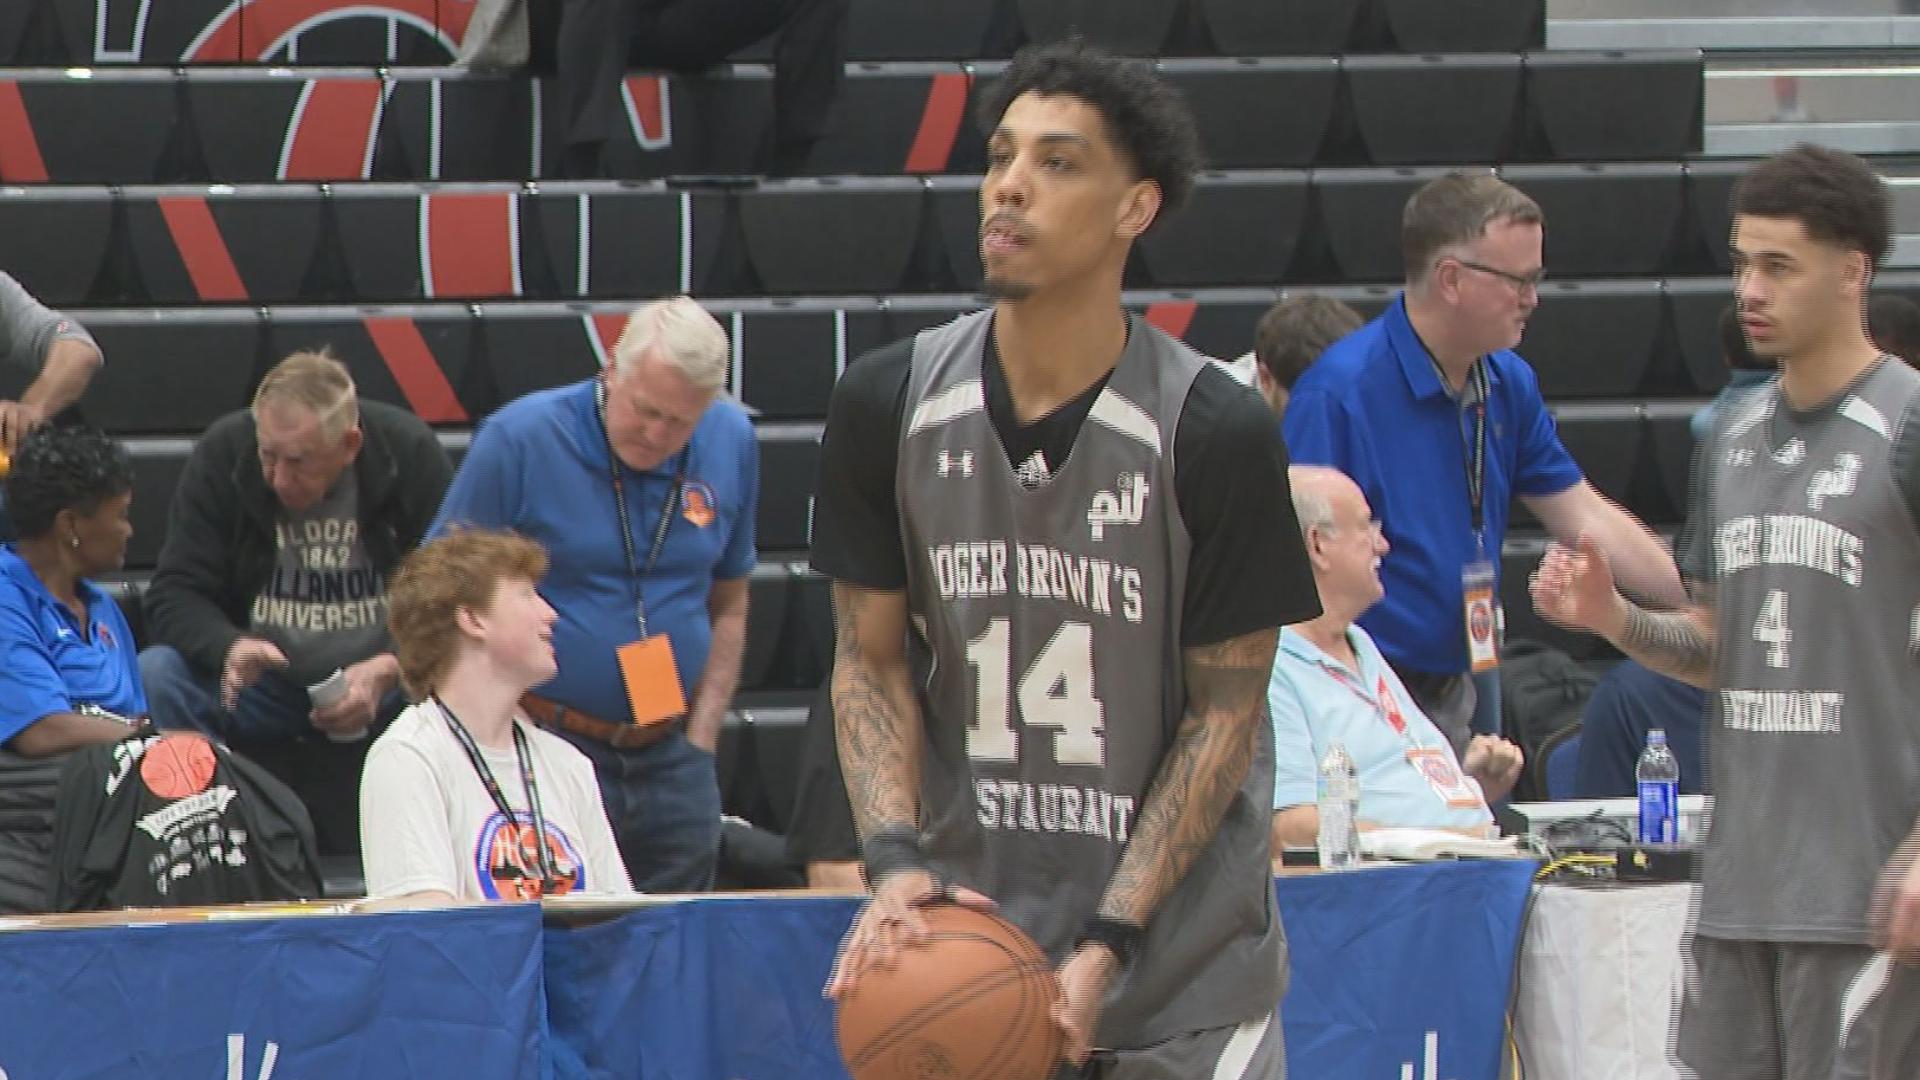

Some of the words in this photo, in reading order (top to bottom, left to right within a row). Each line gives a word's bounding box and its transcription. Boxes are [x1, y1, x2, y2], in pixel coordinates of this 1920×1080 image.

[928, 540, 1008, 599] OGER
[1016, 540, 1142, 624] BROWN'S
[1754, 590, 1793, 668] 4
[965, 616, 1105, 768] 14
[972, 776, 1134, 844] STAURANT
